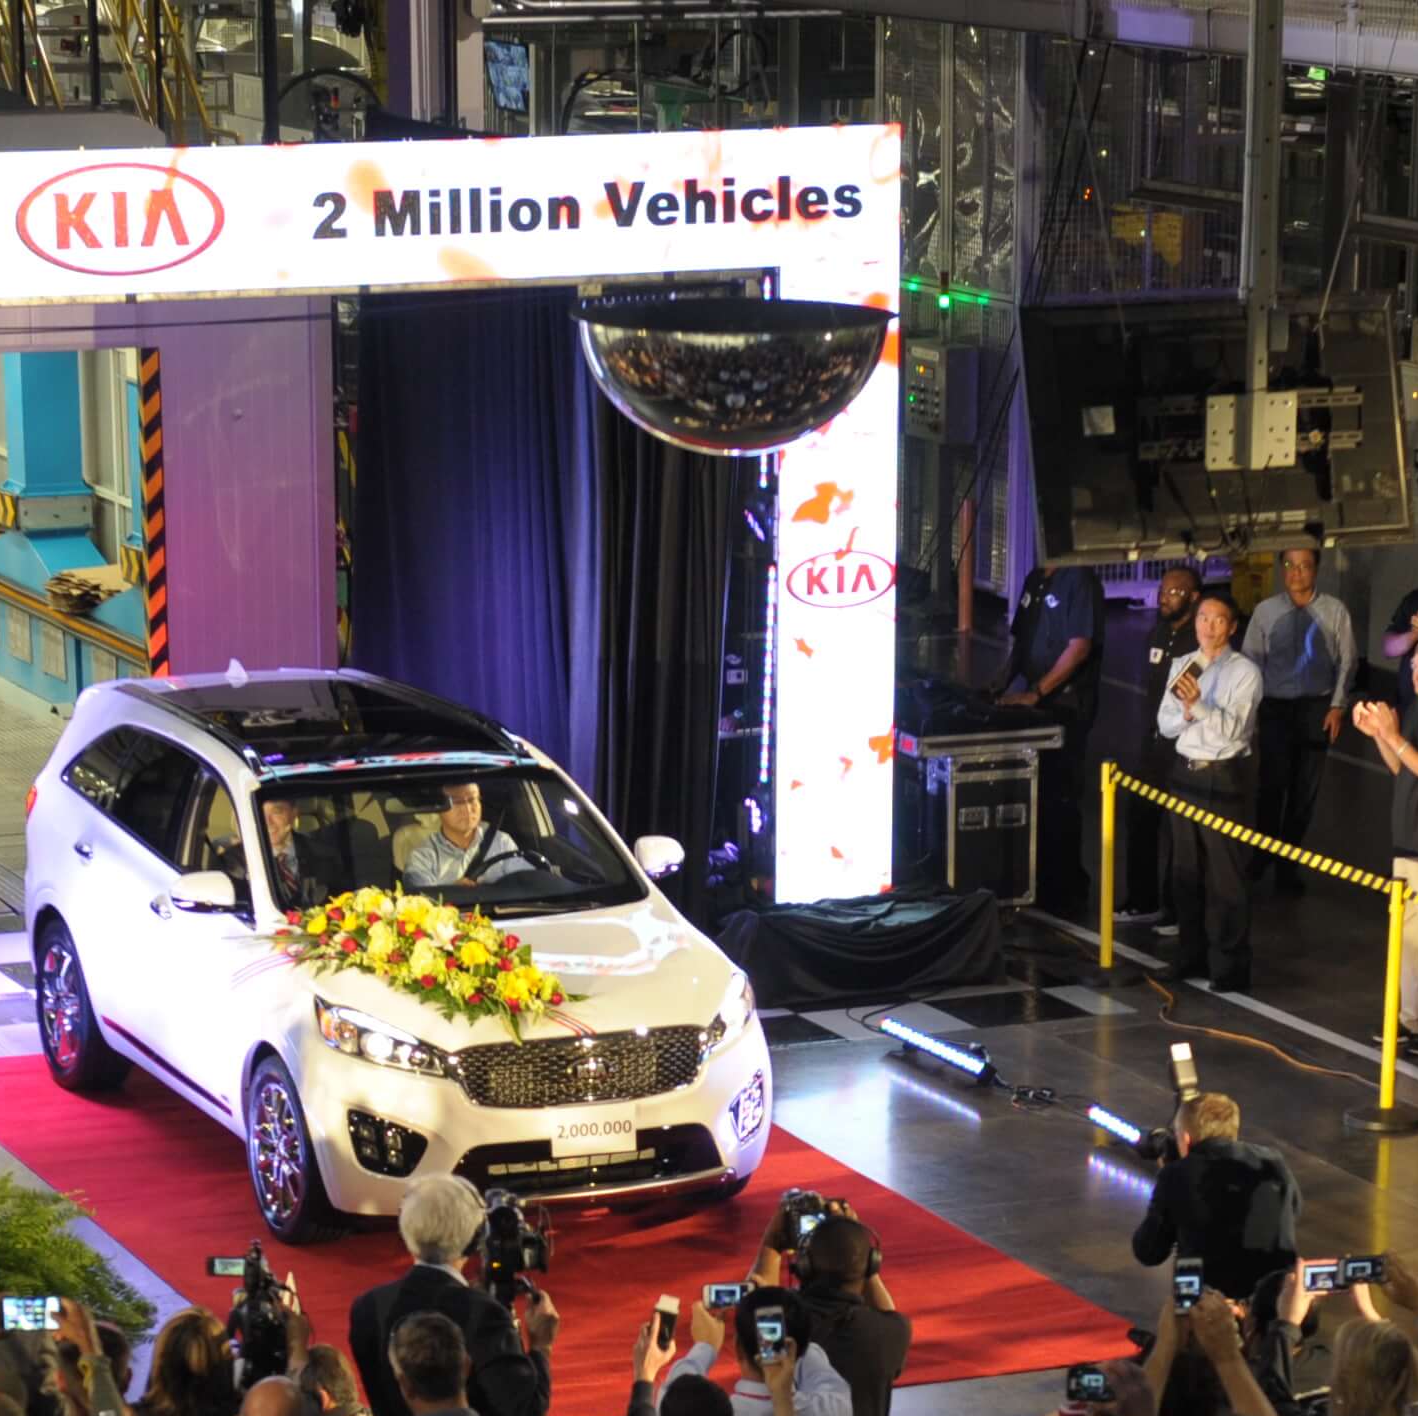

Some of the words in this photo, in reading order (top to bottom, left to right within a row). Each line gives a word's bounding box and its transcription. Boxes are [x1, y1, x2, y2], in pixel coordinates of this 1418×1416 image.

[54, 189, 191, 250] KIA
[312, 191, 348, 240] 2
[373, 187, 582, 237] Million
[604, 175, 863, 228] Vehicles
[807, 564, 877, 596] KIA
[556, 1120, 633, 1140] 2,000,000
